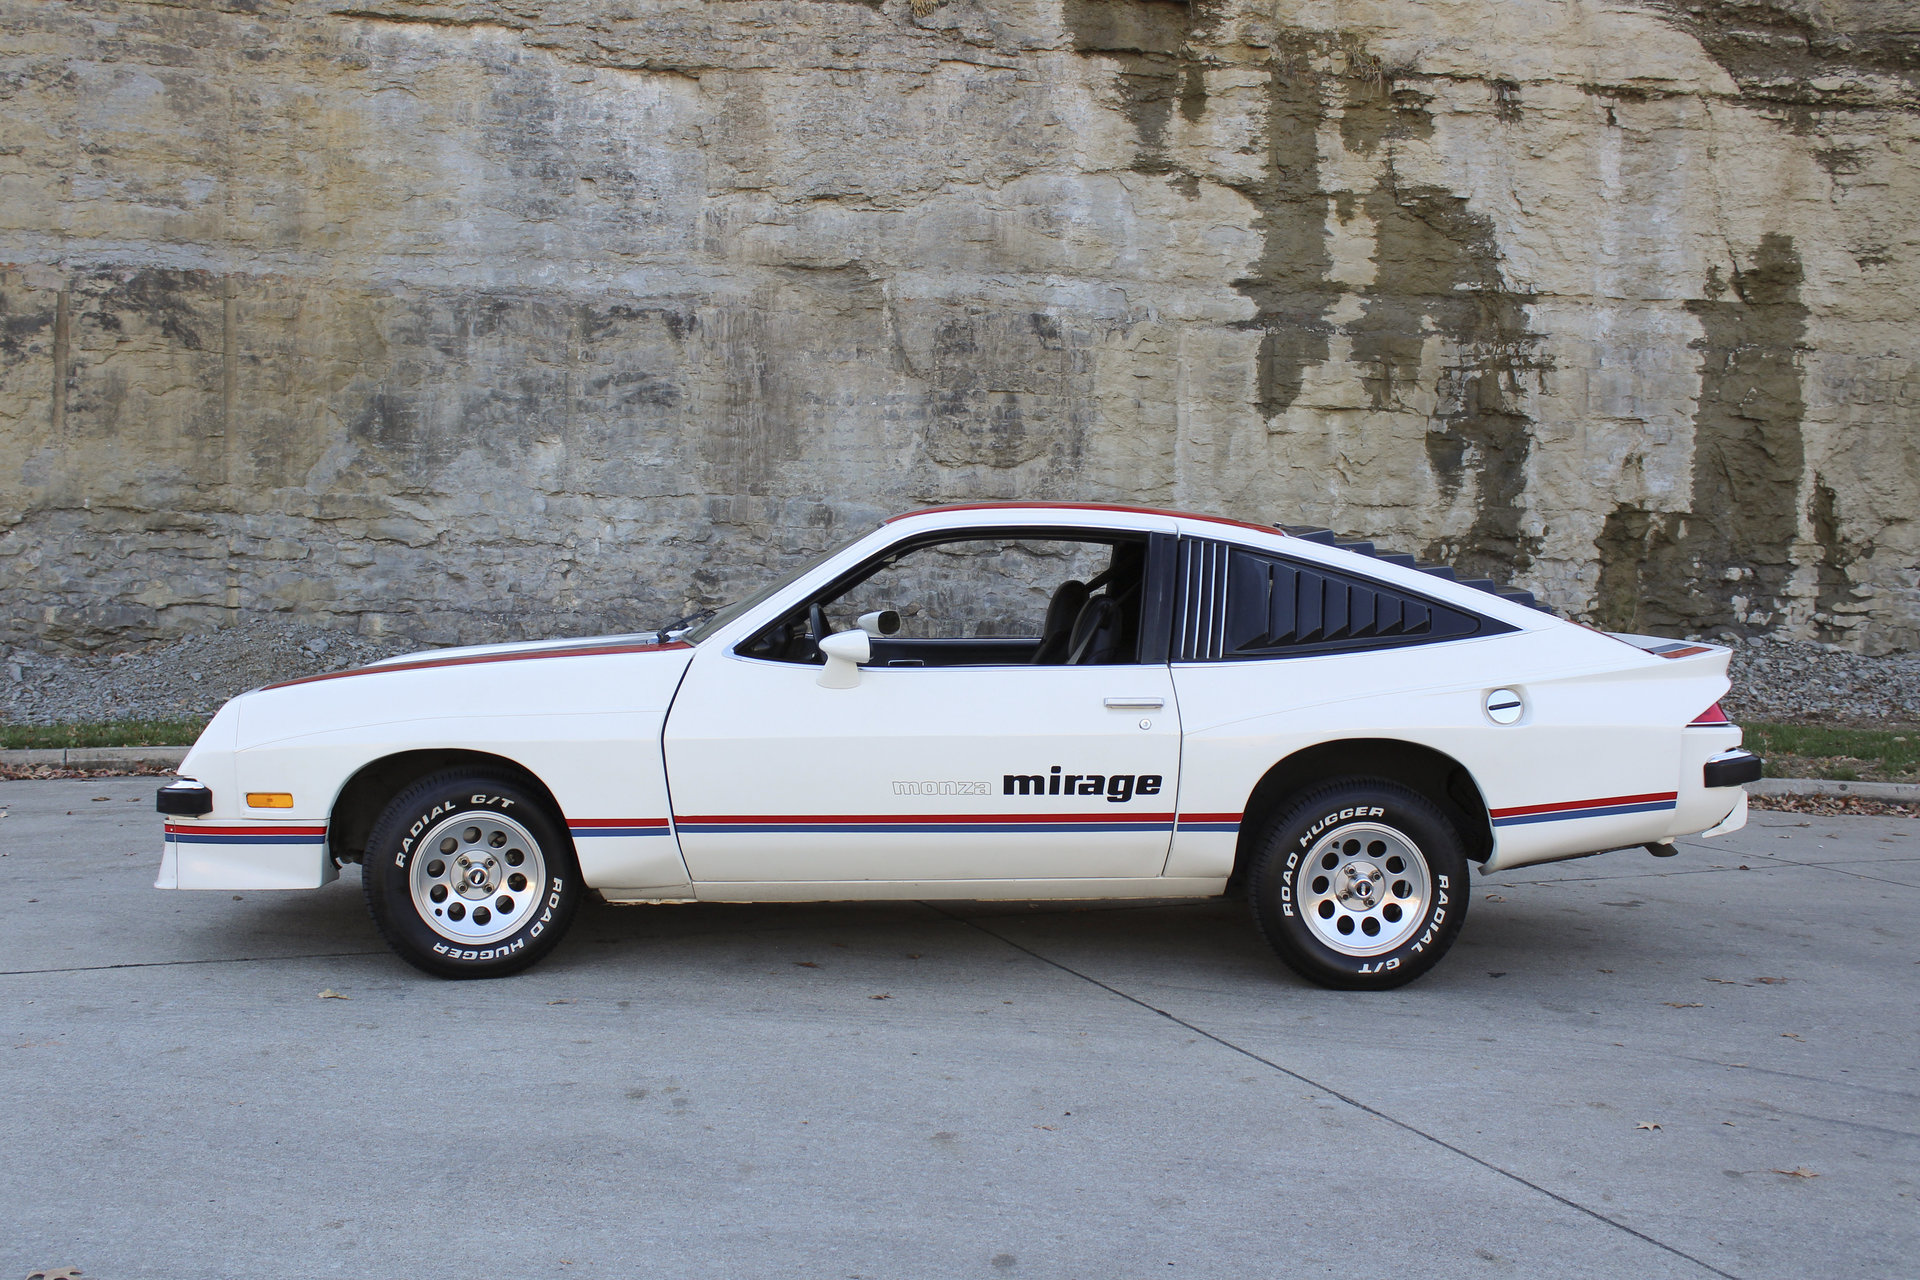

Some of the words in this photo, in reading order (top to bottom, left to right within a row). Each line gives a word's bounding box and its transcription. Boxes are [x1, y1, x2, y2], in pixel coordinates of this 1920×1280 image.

[892, 780, 992, 796] monza
[1003, 765, 1163, 803] mirage
[395, 801, 456, 868] RADIAL
[470, 794, 515, 808] G/T
[1281, 852, 1299, 917] ROAD
[1299, 806, 1385, 848] HUGGER
[529, 877, 563, 938] ROAD
[1411, 874, 1449, 953] RADIAL
[432, 938, 525, 960] HUGGER
[1357, 957, 1401, 974] G/T
